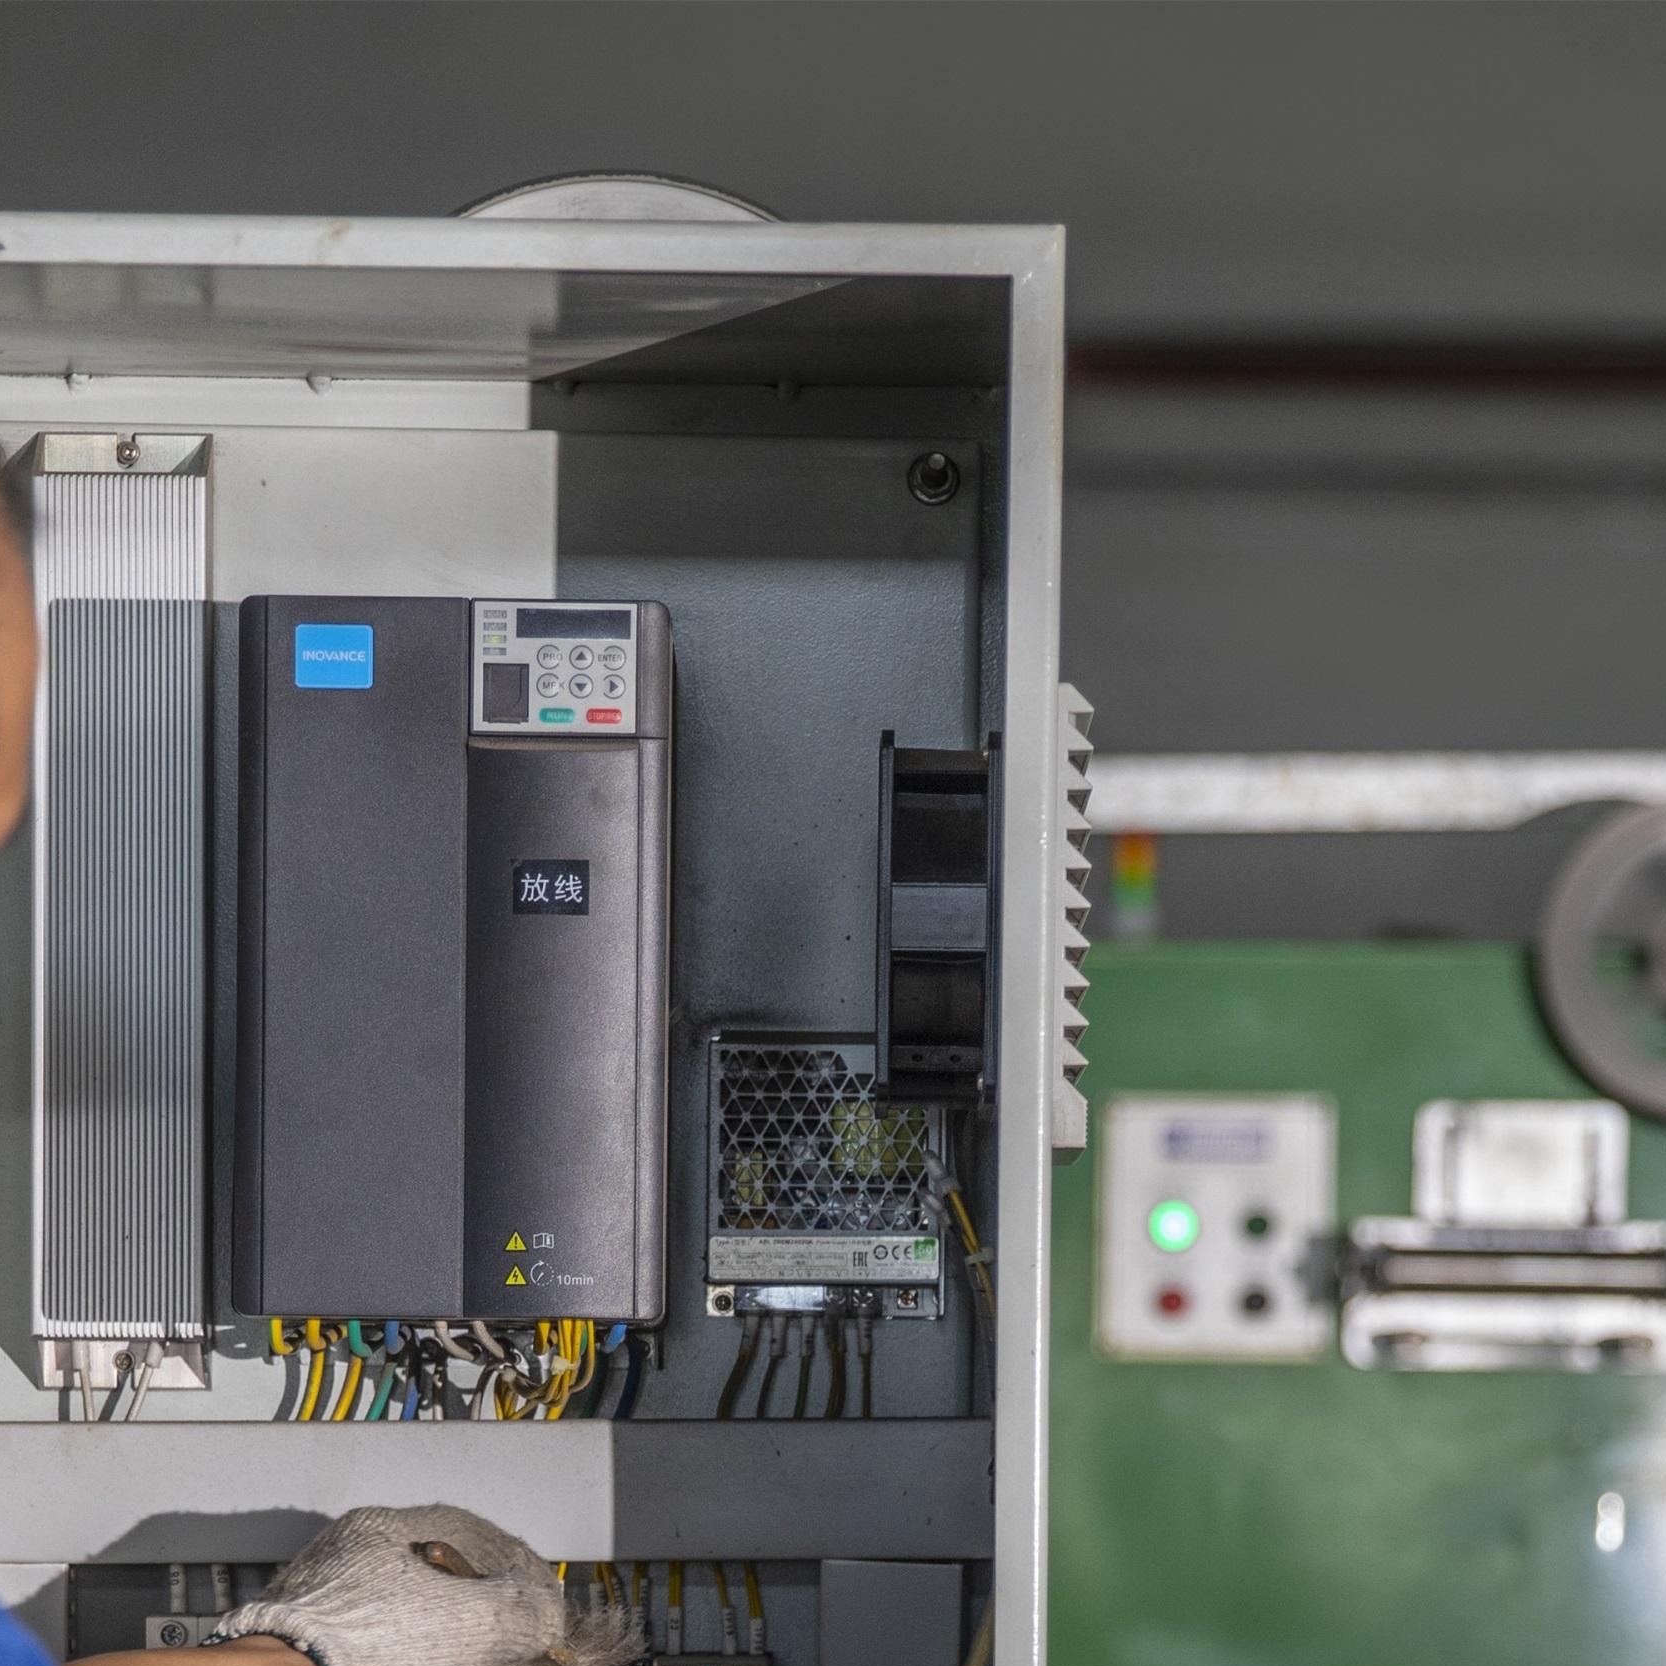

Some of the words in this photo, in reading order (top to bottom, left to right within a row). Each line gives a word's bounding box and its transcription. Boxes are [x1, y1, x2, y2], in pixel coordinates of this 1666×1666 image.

[301, 650, 366, 662] INOVANCE
[542, 653, 563, 661] PRG
[598, 653, 623, 662] ENTER
[520, 873, 584, 903] 放线
[556, 1274, 594, 1286] 10min
